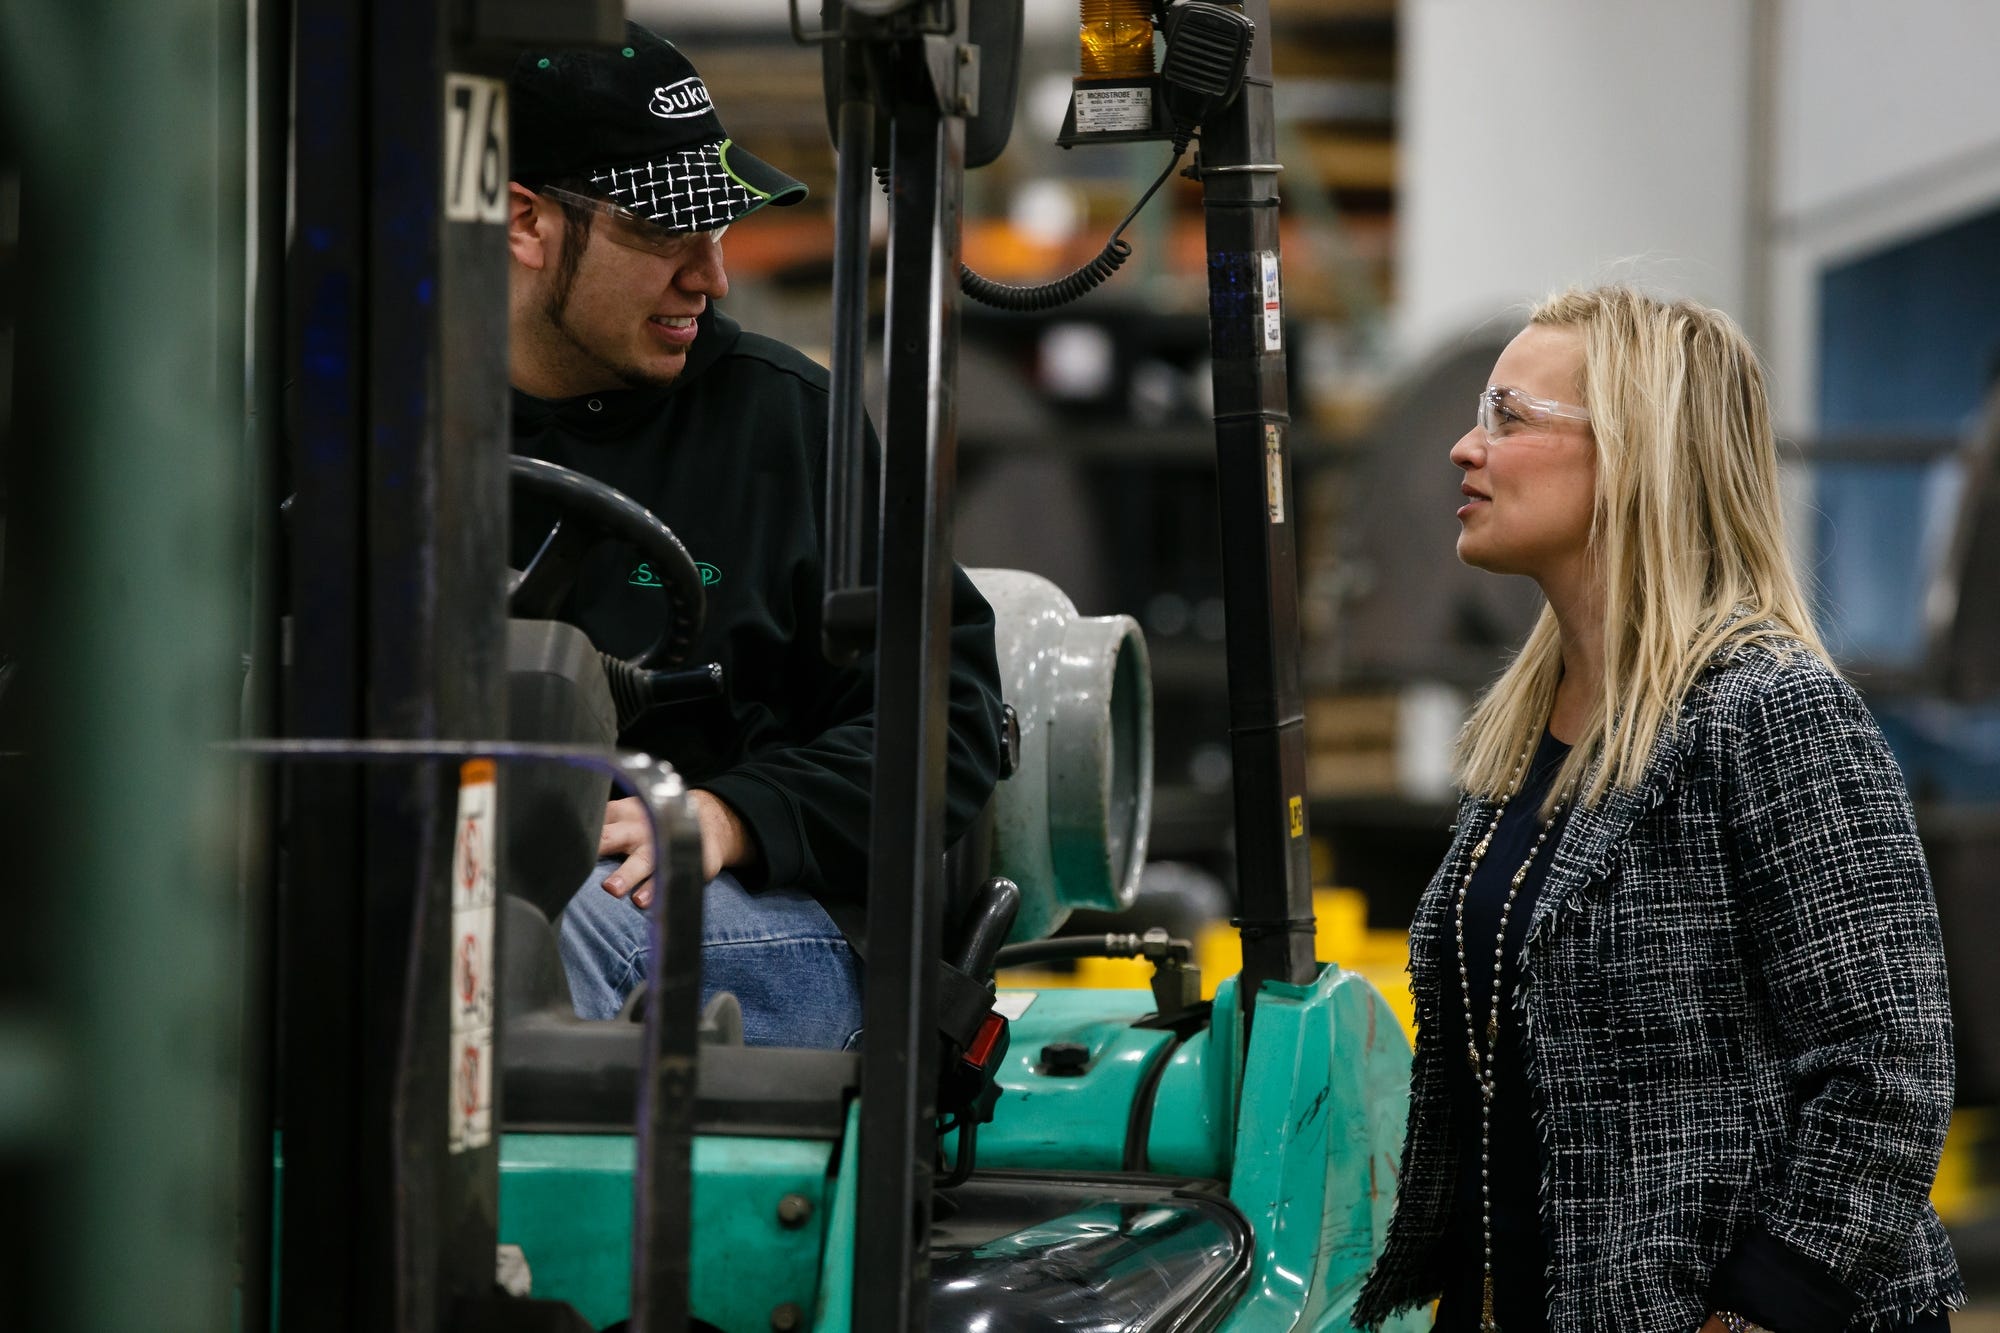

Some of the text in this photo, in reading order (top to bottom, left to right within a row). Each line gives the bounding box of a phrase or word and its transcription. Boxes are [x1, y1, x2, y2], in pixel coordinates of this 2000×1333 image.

[654, 84, 709, 113] Suku
[1087, 91, 1130, 99] MICROSTROBE
[454, 86, 500, 207] 76
